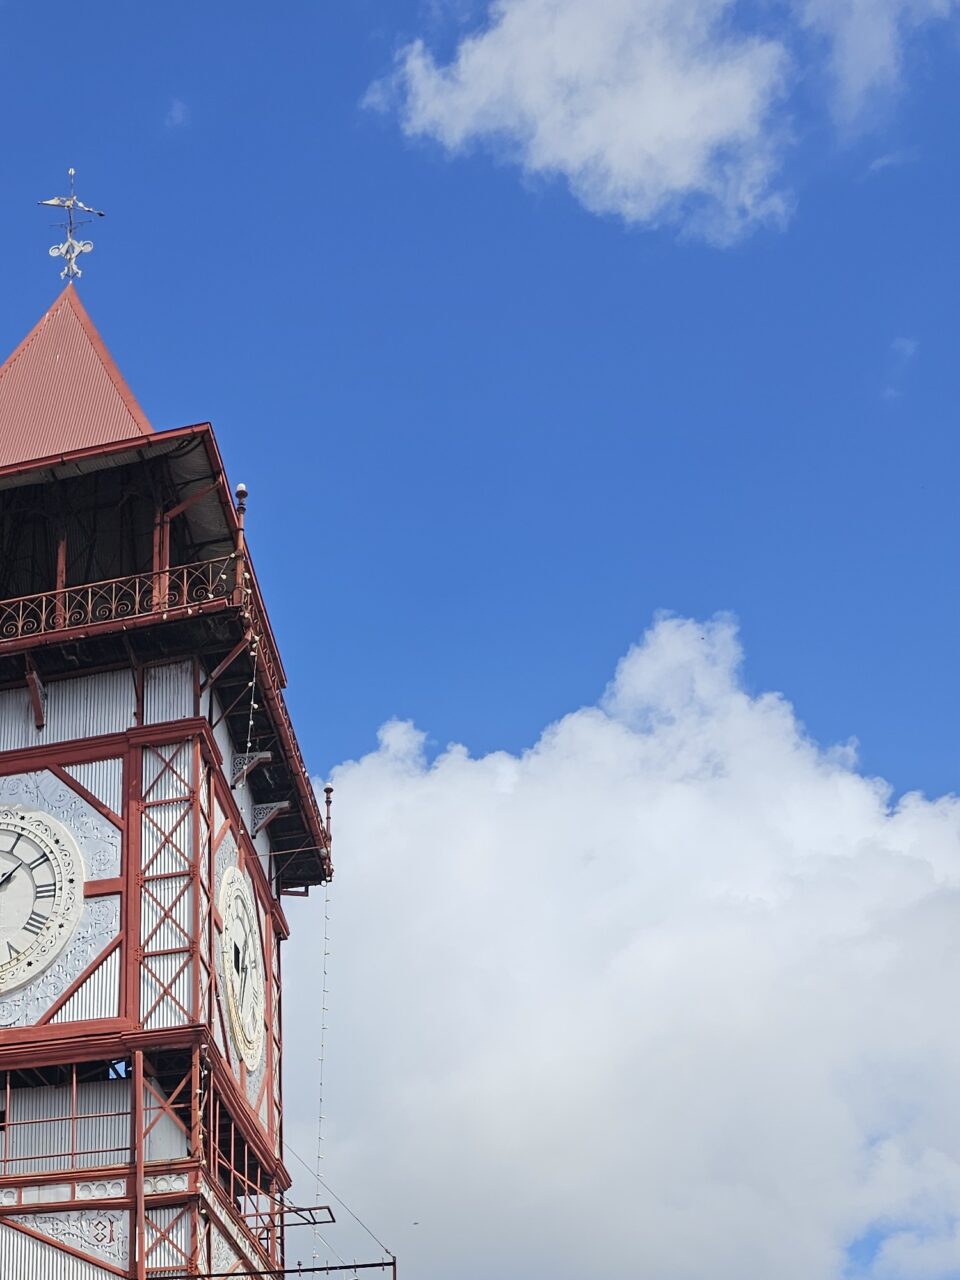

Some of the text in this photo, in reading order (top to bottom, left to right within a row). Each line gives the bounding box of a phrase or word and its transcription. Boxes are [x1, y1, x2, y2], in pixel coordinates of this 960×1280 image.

[8, 832, 23, 855] I
[28, 852, 49, 870] II
[35, 883, 56, 900] III
[22, 911, 49, 936] IIII
[6, 941, 22, 960] V
